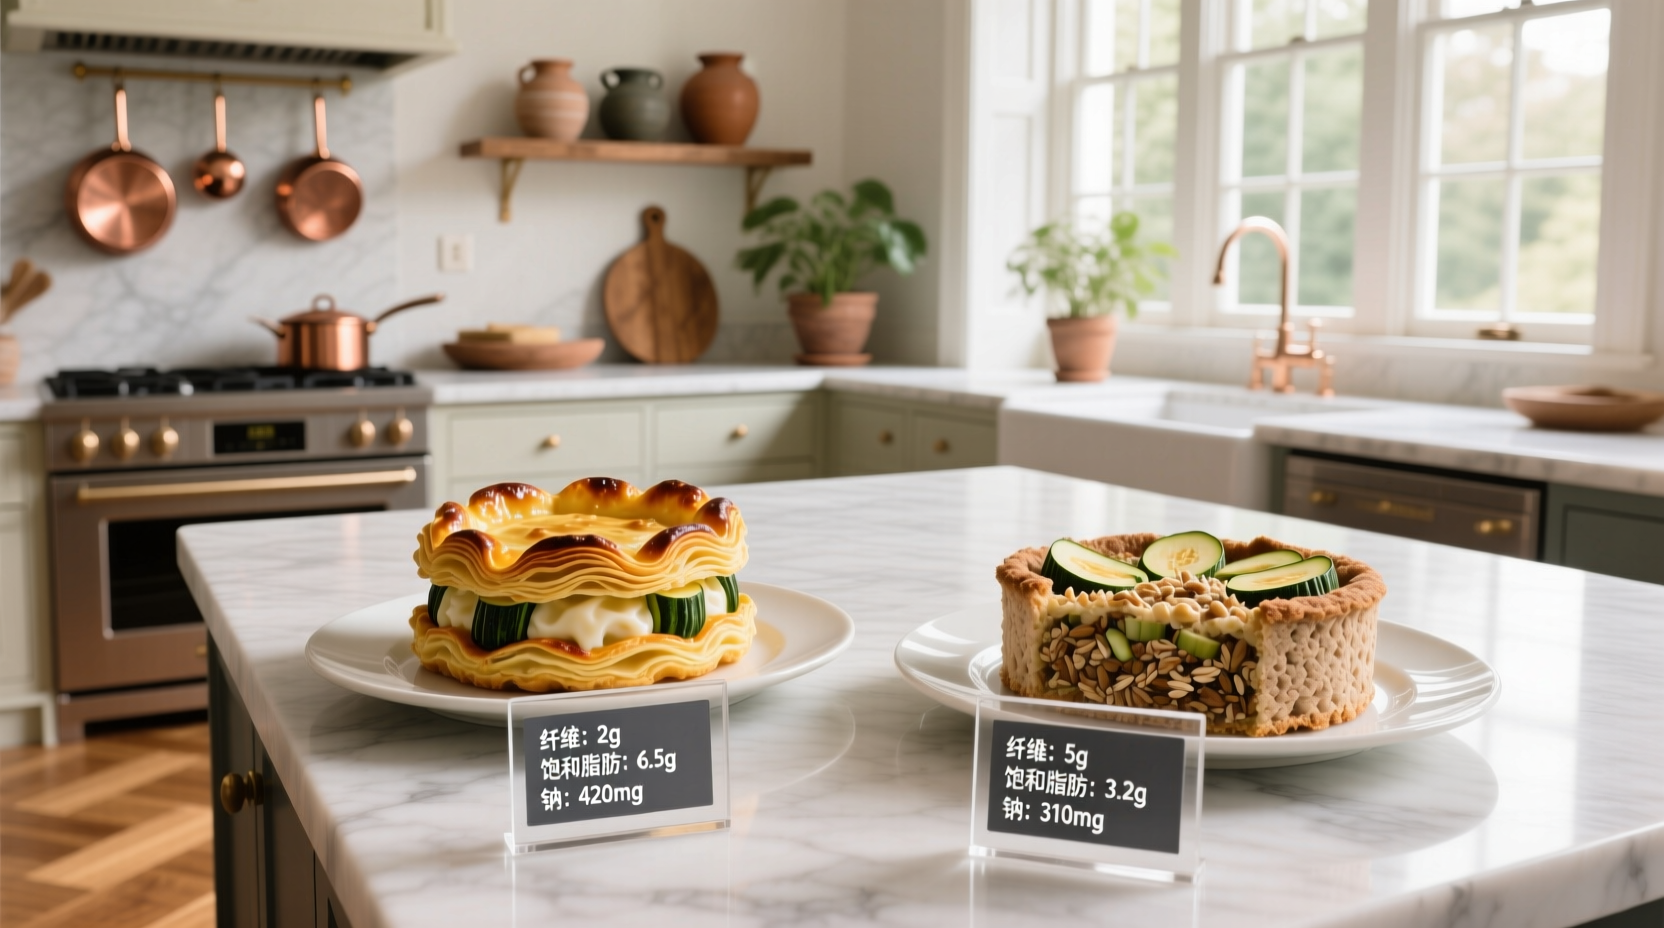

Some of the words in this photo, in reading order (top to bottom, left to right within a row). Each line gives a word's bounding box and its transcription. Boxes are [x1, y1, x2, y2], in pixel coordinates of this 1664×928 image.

[597, 724, 621, 748] 2g
[636, 748, 677, 773] 6.5g
[1064, 743, 1089, 771] 5g
[578, 783, 644, 805] 420mg
[1104, 778, 1147, 808] 3.2g
[1039, 802, 1105, 835] 310mg
